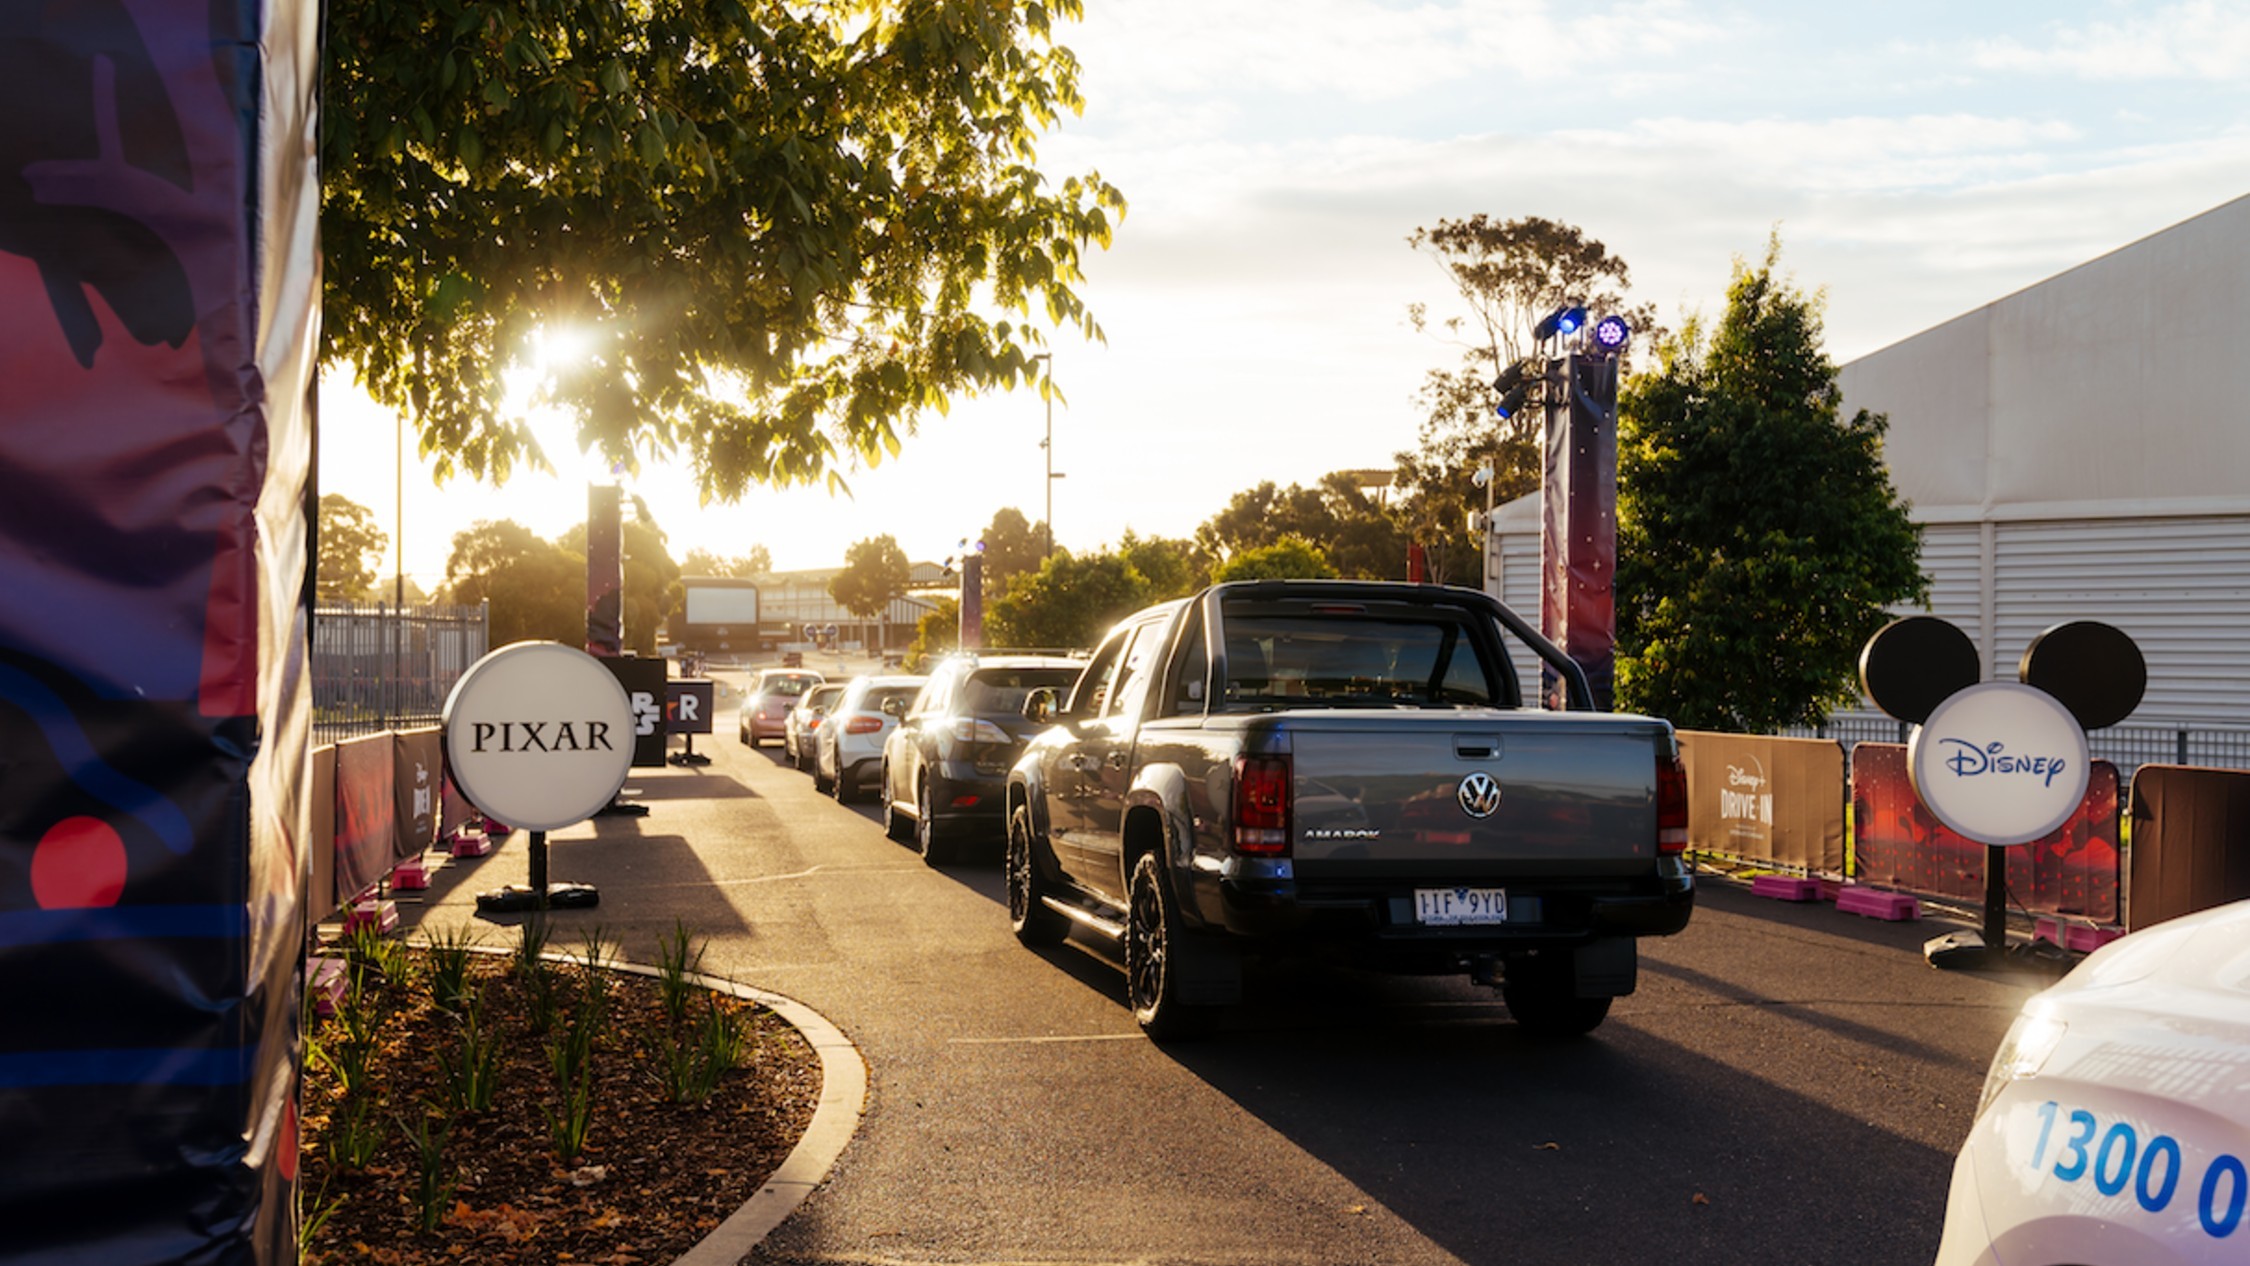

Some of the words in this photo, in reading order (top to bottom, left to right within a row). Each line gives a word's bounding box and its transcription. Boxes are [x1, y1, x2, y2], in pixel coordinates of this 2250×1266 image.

[471, 721, 614, 752] PIXAR
[1938, 738, 2066, 787] Disney
[1304, 829, 1381, 840] AMAROK
[2031, 1100, 2181, 1213] 1300
[2198, 1153, 2248, 1239] 0
